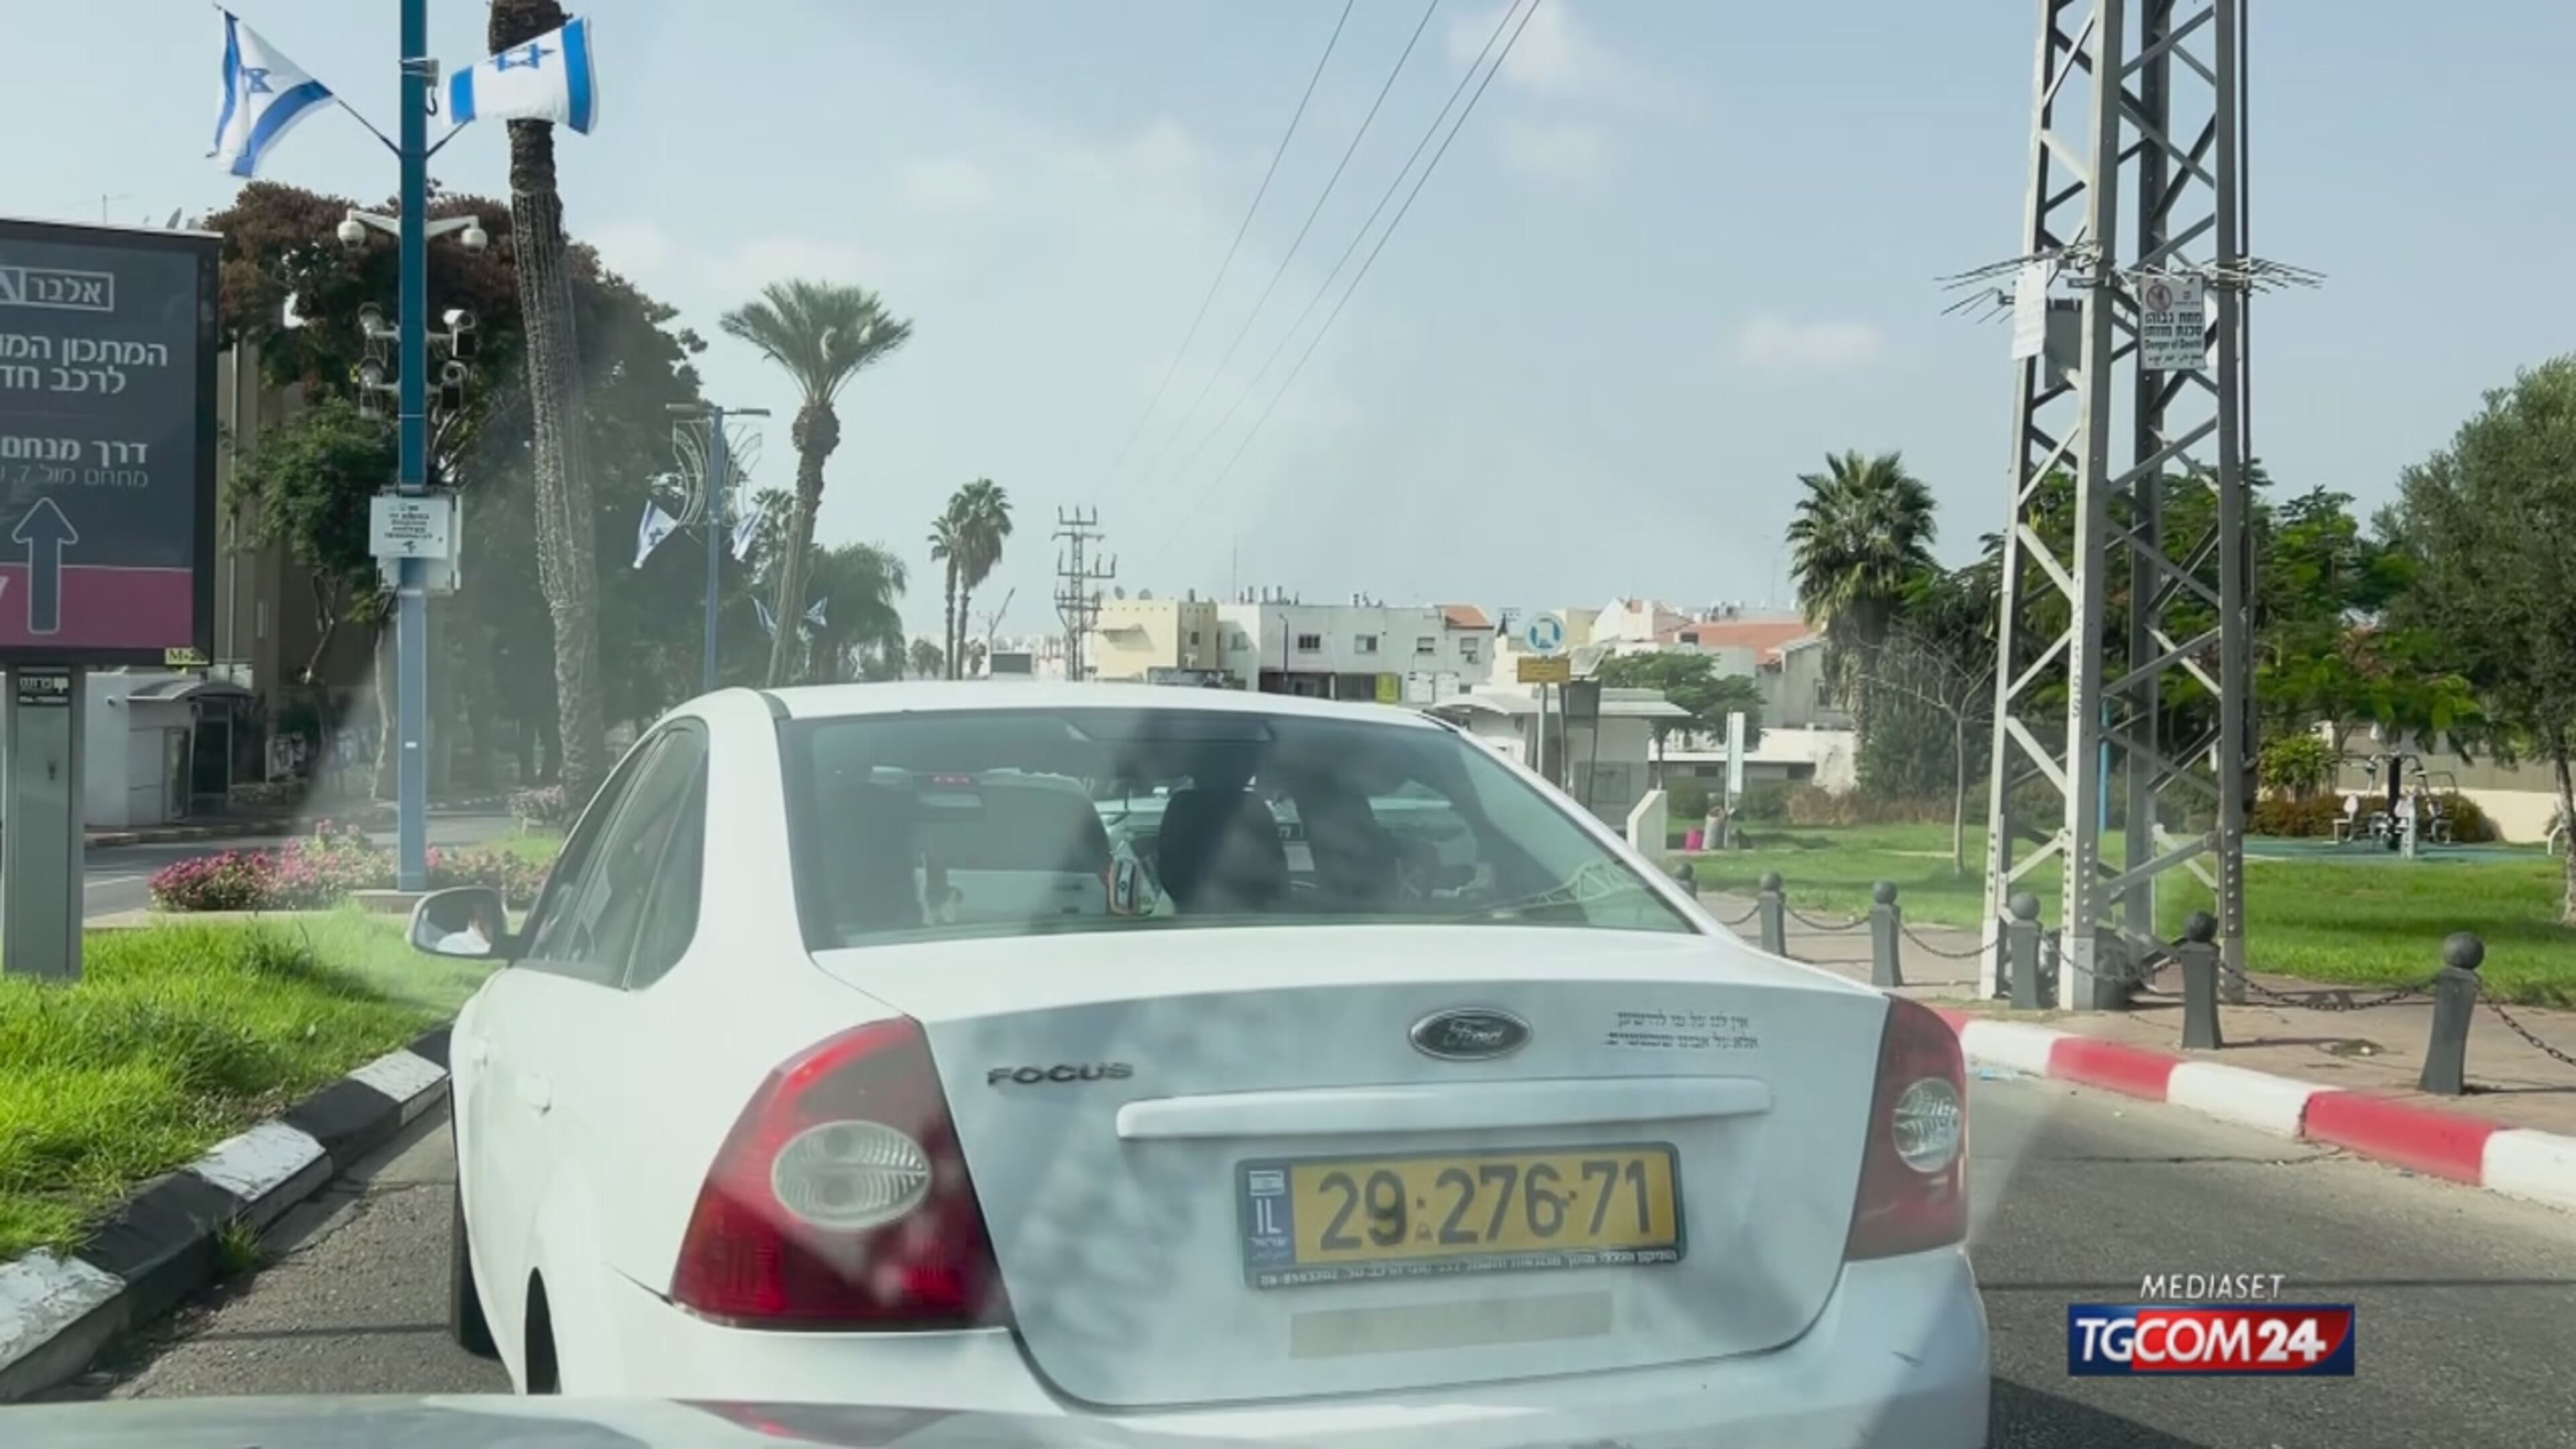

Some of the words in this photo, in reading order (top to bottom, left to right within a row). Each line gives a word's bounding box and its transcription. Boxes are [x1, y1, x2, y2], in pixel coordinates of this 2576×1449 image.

[31, 277, 101, 303] אלבר
[62, 338, 167, 366] המתכון
[50, 366, 126, 394] לרכב
[1, 436, 81, 461] מנחם
[91, 440, 148, 468] דרך
[39, 463, 76, 484] מול
[84, 470, 148, 488] מתחם
[987, 1062, 1134, 1087] FOCUS
[1256, 1199, 1283, 1234] IL
